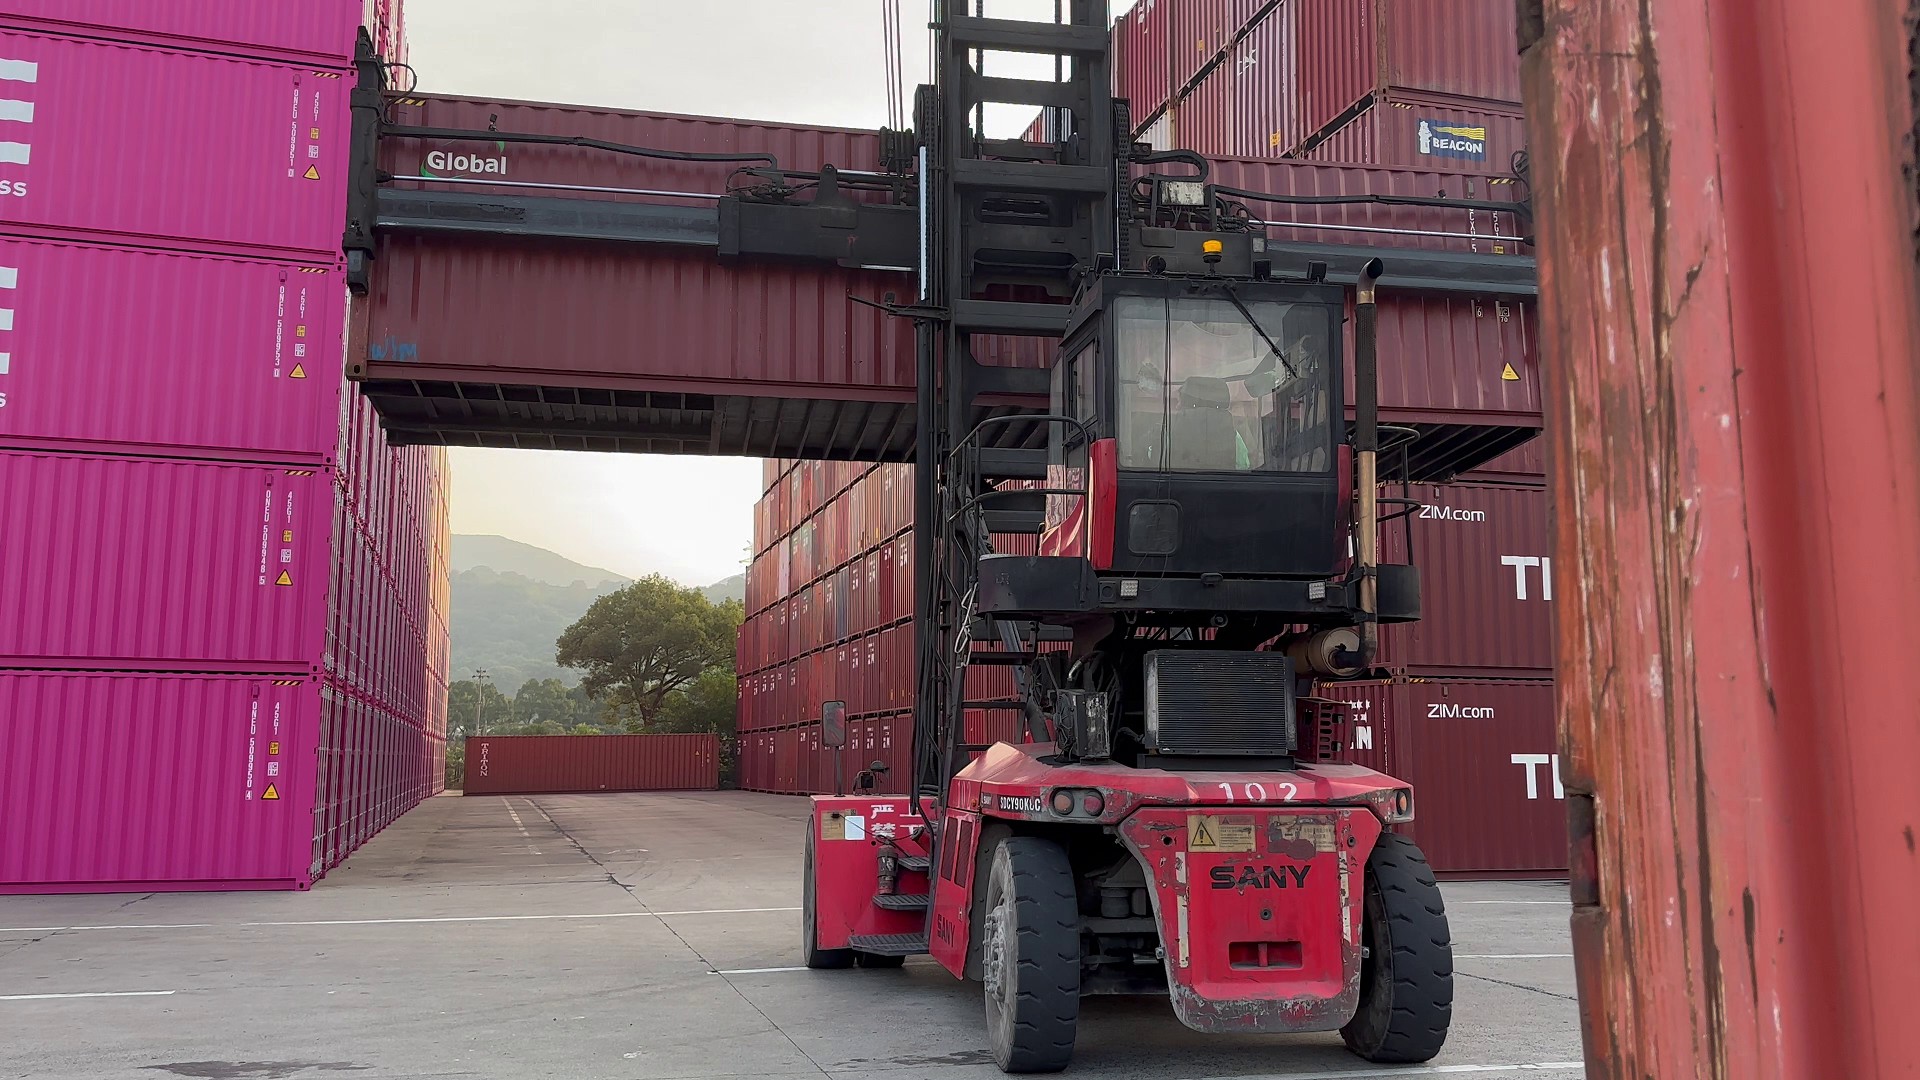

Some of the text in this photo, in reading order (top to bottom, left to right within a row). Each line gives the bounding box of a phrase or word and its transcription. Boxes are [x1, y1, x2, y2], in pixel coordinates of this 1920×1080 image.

[1432, 137, 1483, 154] BEACON
[427, 150, 507, 175] Global
[1419, 505, 1485, 522] ZIM.com
[1427, 703, 1494, 719] ZIM.com
[480, 743, 490, 777] TRITON
[1219, 782, 1301, 804] 102
[1210, 865, 1311, 889] SANY
[937, 914, 956, 948] SANY
